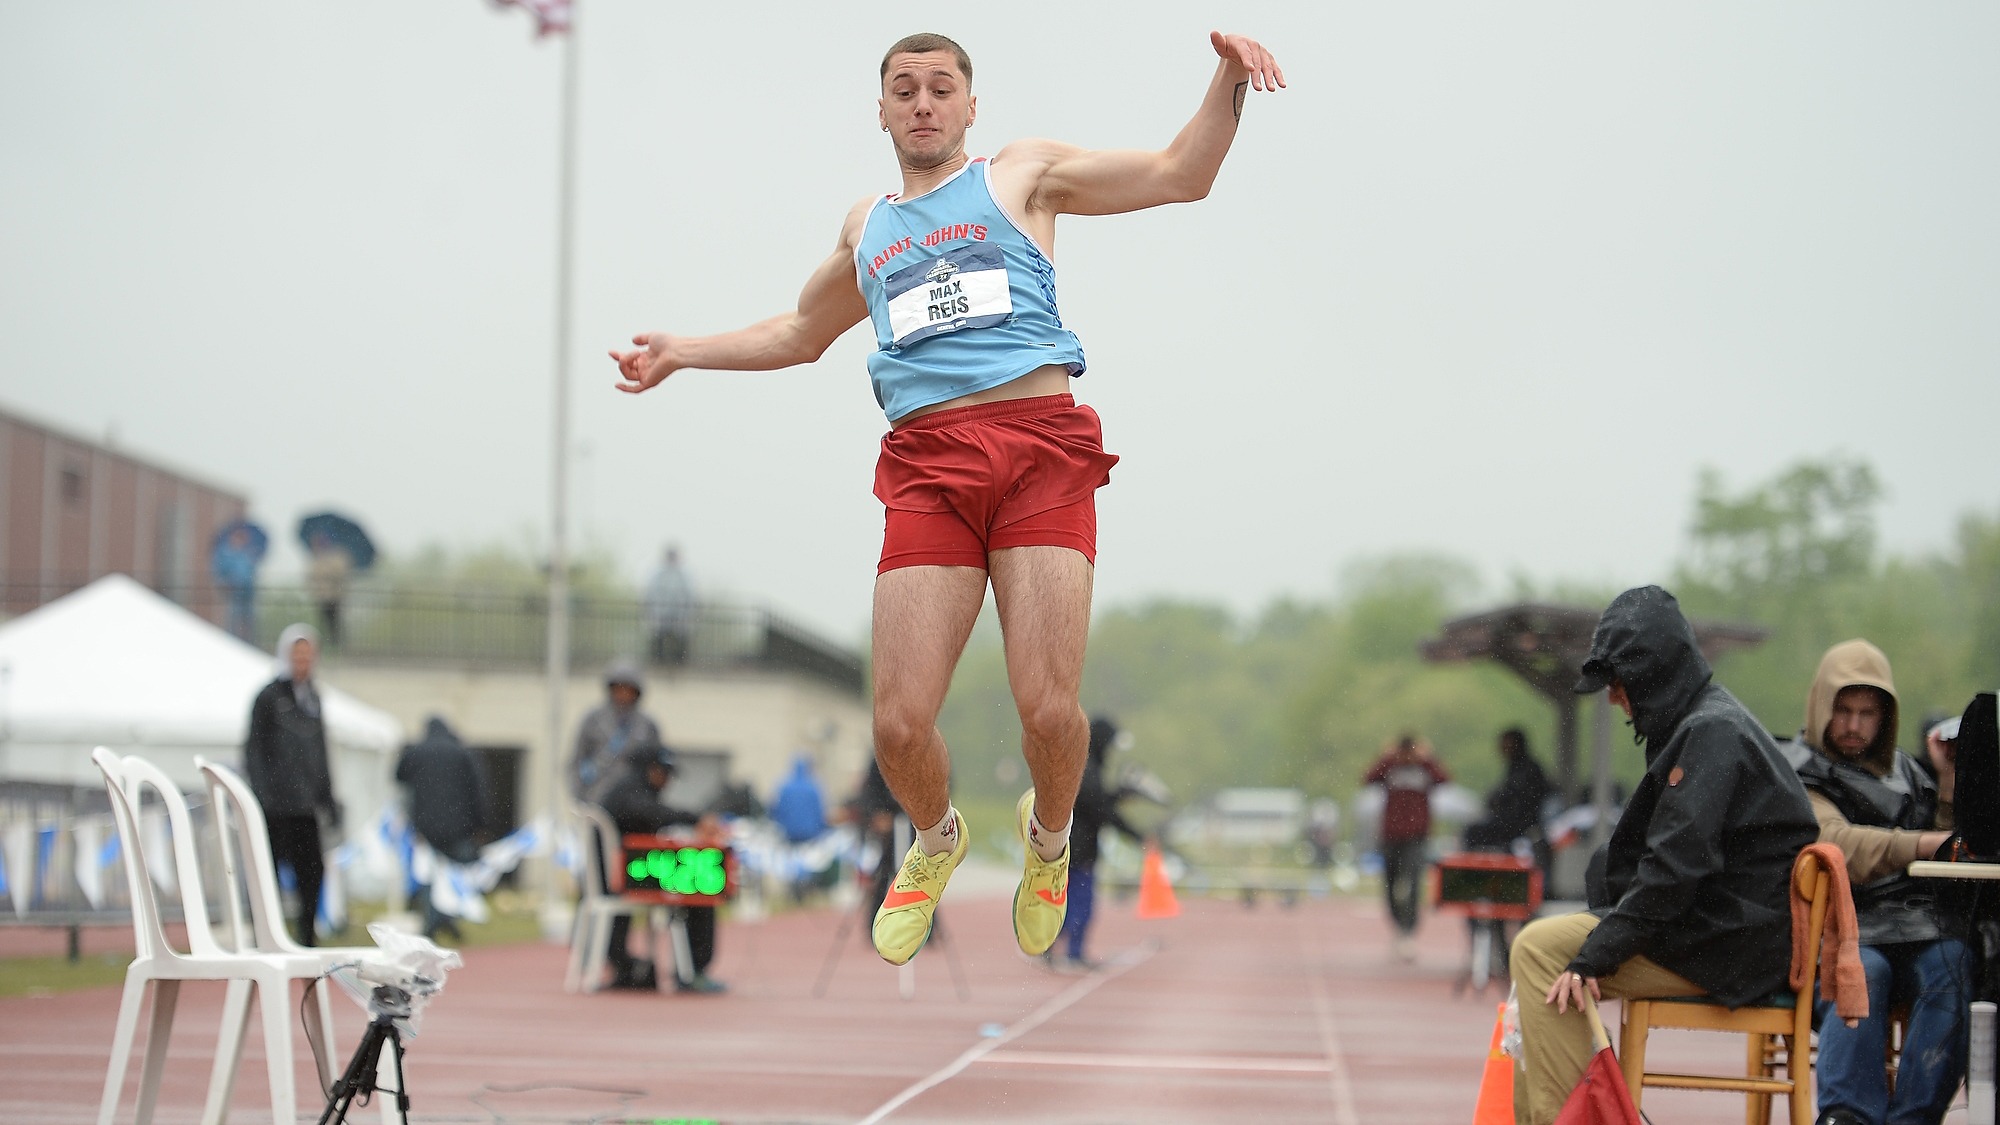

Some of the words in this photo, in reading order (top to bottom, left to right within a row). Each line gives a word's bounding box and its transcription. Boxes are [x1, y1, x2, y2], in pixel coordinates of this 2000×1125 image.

[867, 236, 912, 279] SAINT
[920, 223, 988, 246] JOHN'S
[929, 280, 963, 301] MAX
[927, 295, 970, 322] REIS
